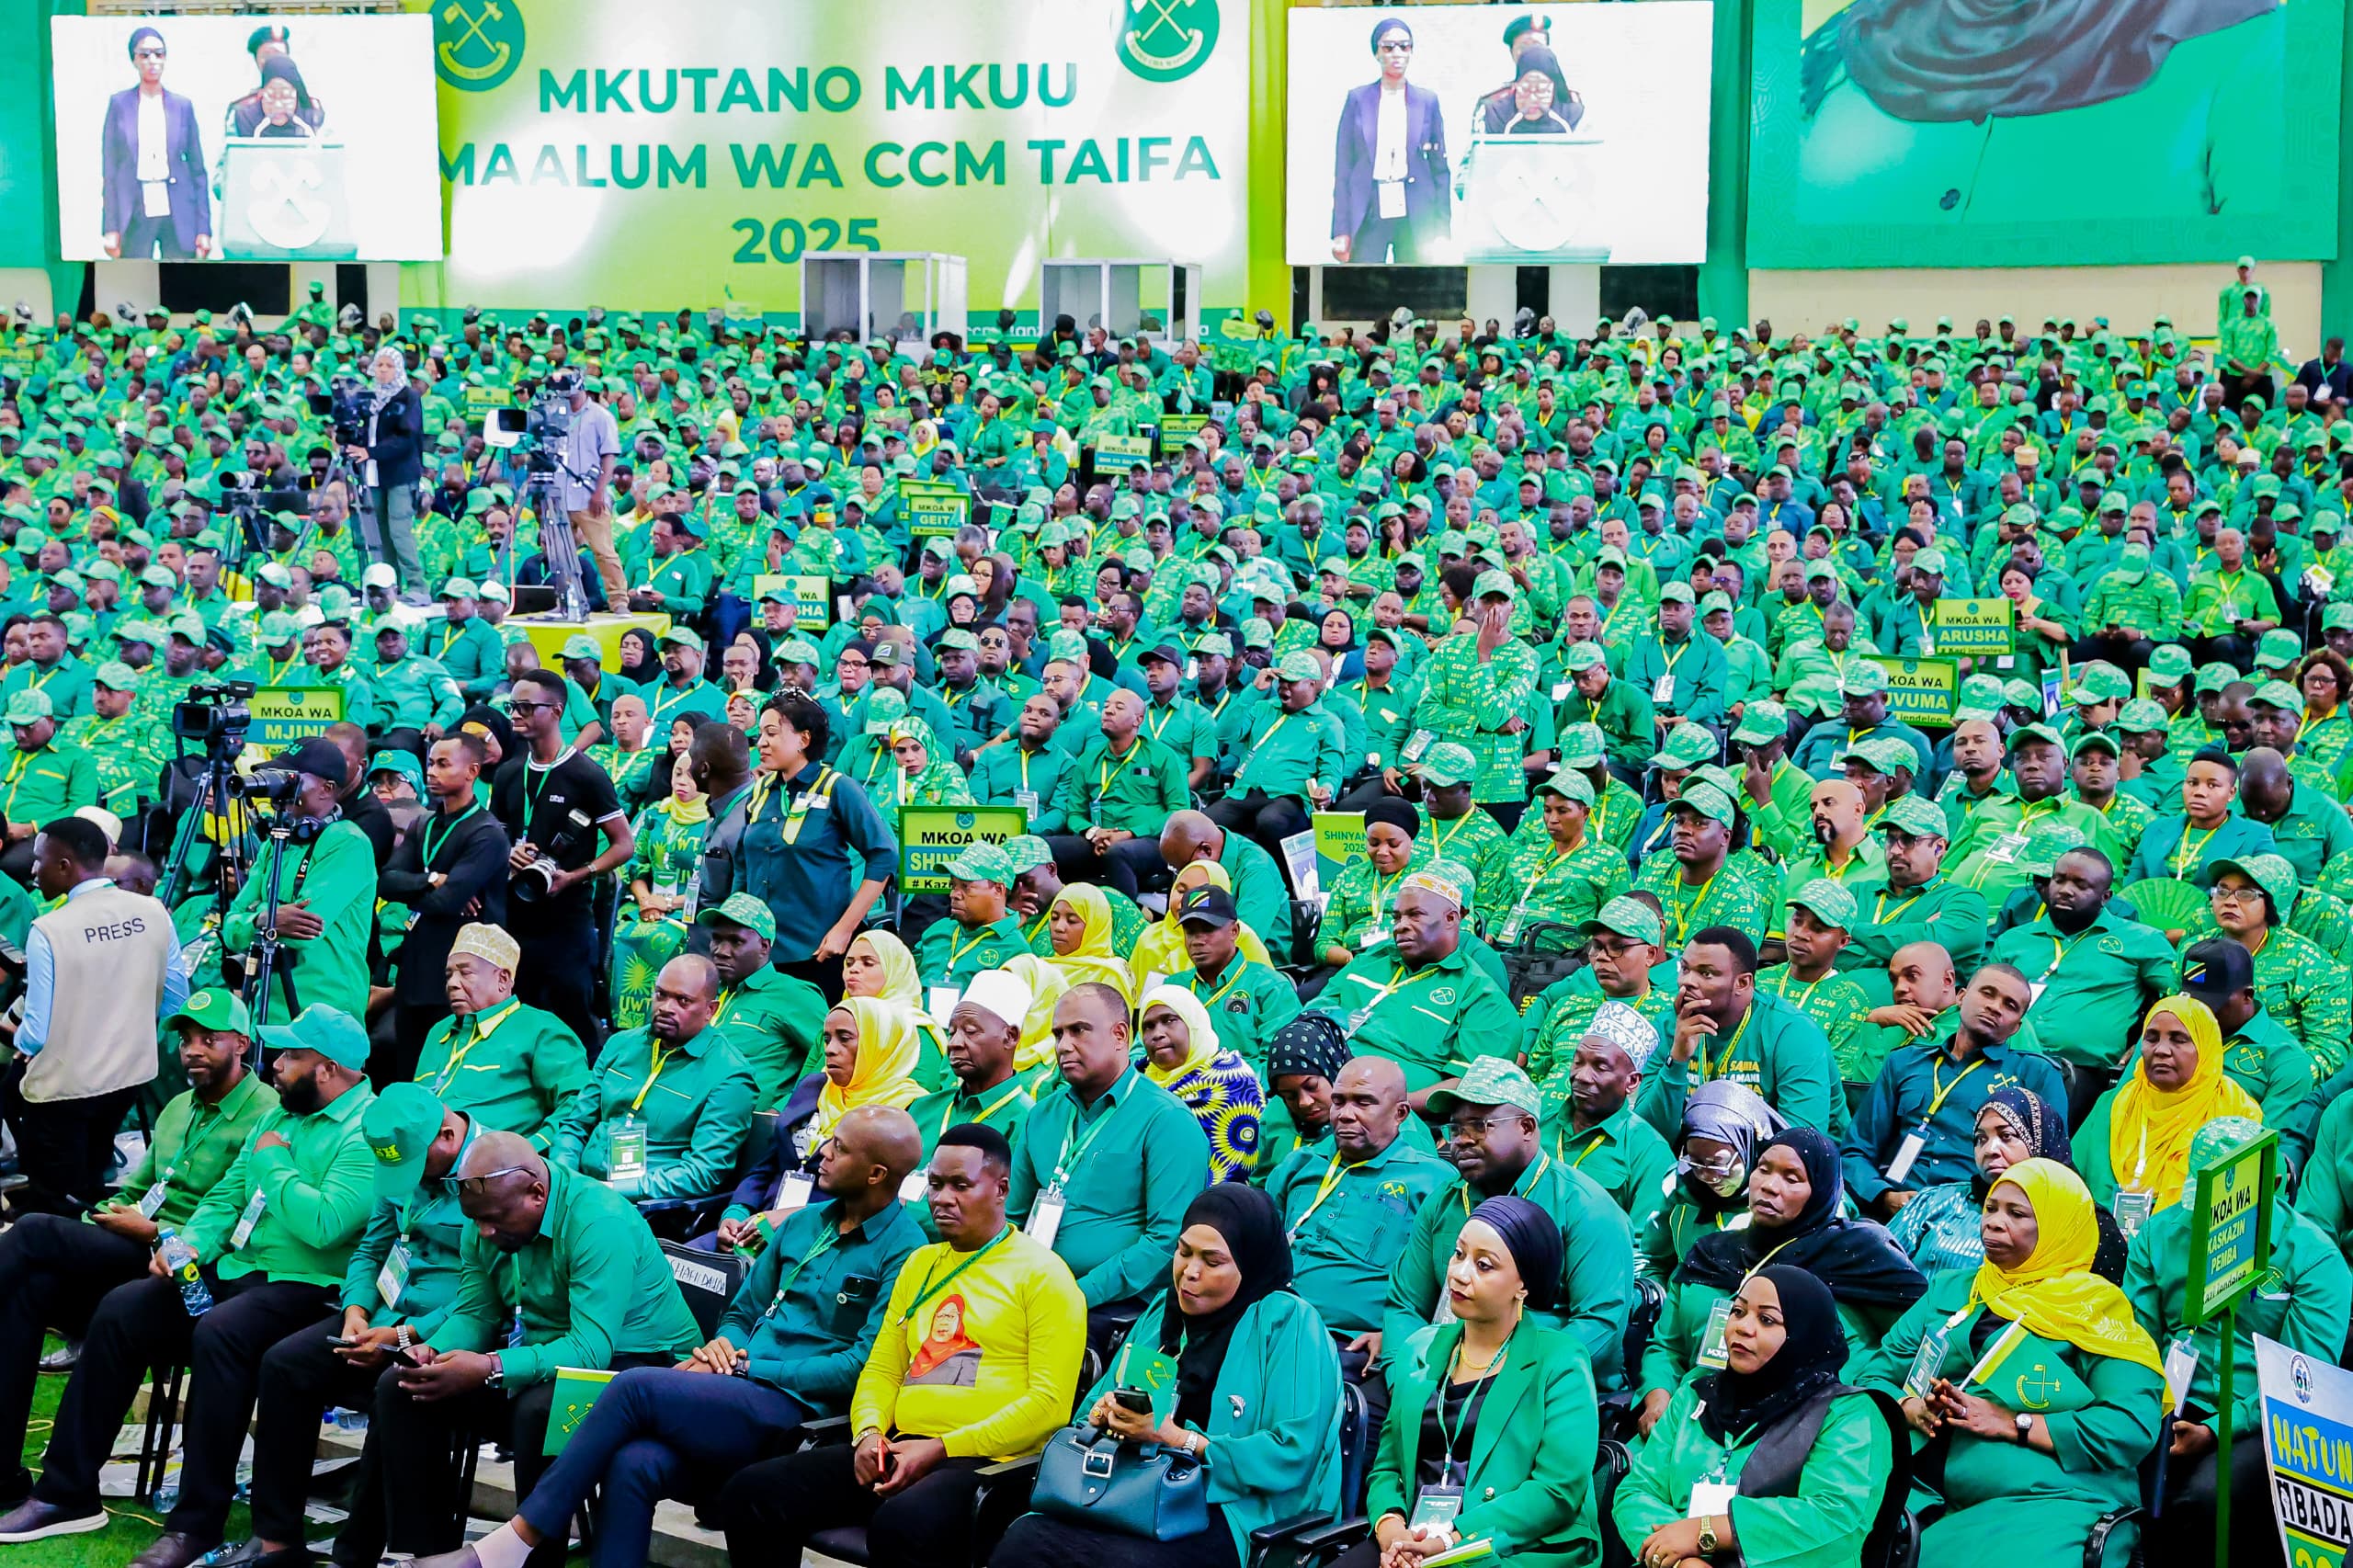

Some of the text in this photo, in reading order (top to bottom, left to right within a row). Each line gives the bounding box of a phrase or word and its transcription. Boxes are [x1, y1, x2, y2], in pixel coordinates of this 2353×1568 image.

[539, 63, 1077, 114] MKUTANO MKUU
[441, 136, 1221, 190] MAALUM WA CCM TAIFA
[731, 218, 880, 265] 2025
[919, 515, 950, 525] GEIT
[801, 592, 818, 600] WA
[1939, 630, 2009, 642] ARUSHA
[1888, 676, 1943, 687] KOA WA
[1885, 692, 1949, 710] UVUMA
[261, 707, 332, 718] MKOA WA
[921, 832, 1007, 845] MKOA WA
[1324, 830, 1368, 841] SHINYAN
[1344, 843, 1367, 853] 2025
[85, 917, 145, 943] PRESS
[1789, 990, 1802, 998] SS
[1813, 996, 1836, 1008] CCM
[2211, 1186, 2251, 1228] KOA WA
[2211, 1245, 2237, 1275] PEMBA
[2272, 1414, 2353, 1484] HATUN
[2277, 1479, 2353, 1541] MBADA
